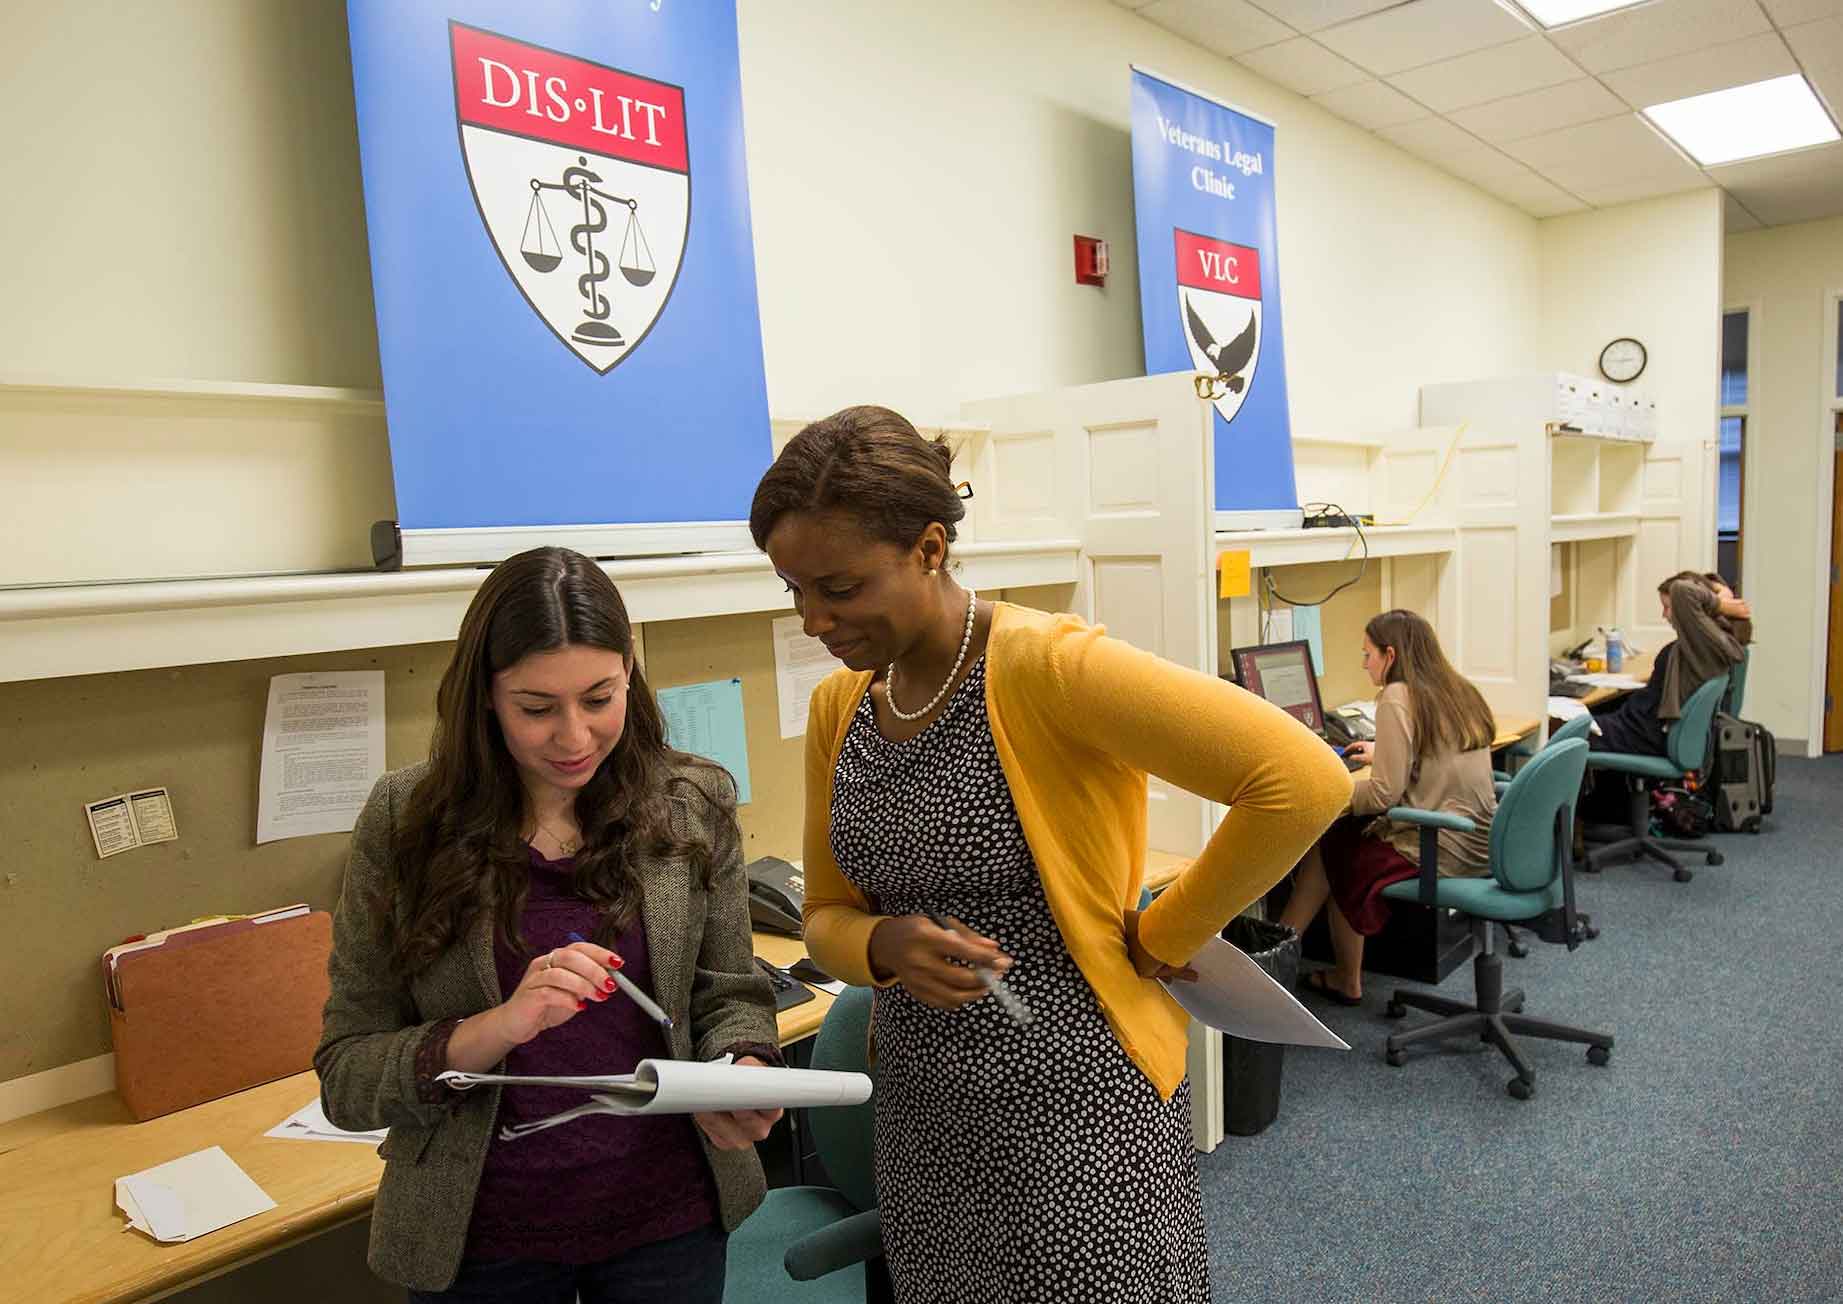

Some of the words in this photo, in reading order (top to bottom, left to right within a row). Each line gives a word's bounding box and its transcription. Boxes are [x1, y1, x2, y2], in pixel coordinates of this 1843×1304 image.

[1157, 116, 1221, 161] Veterans
[1223, 141, 1264, 176] Legal
[1191, 165, 1236, 200] Clinic
[1197, 249, 1239, 284] VLC
